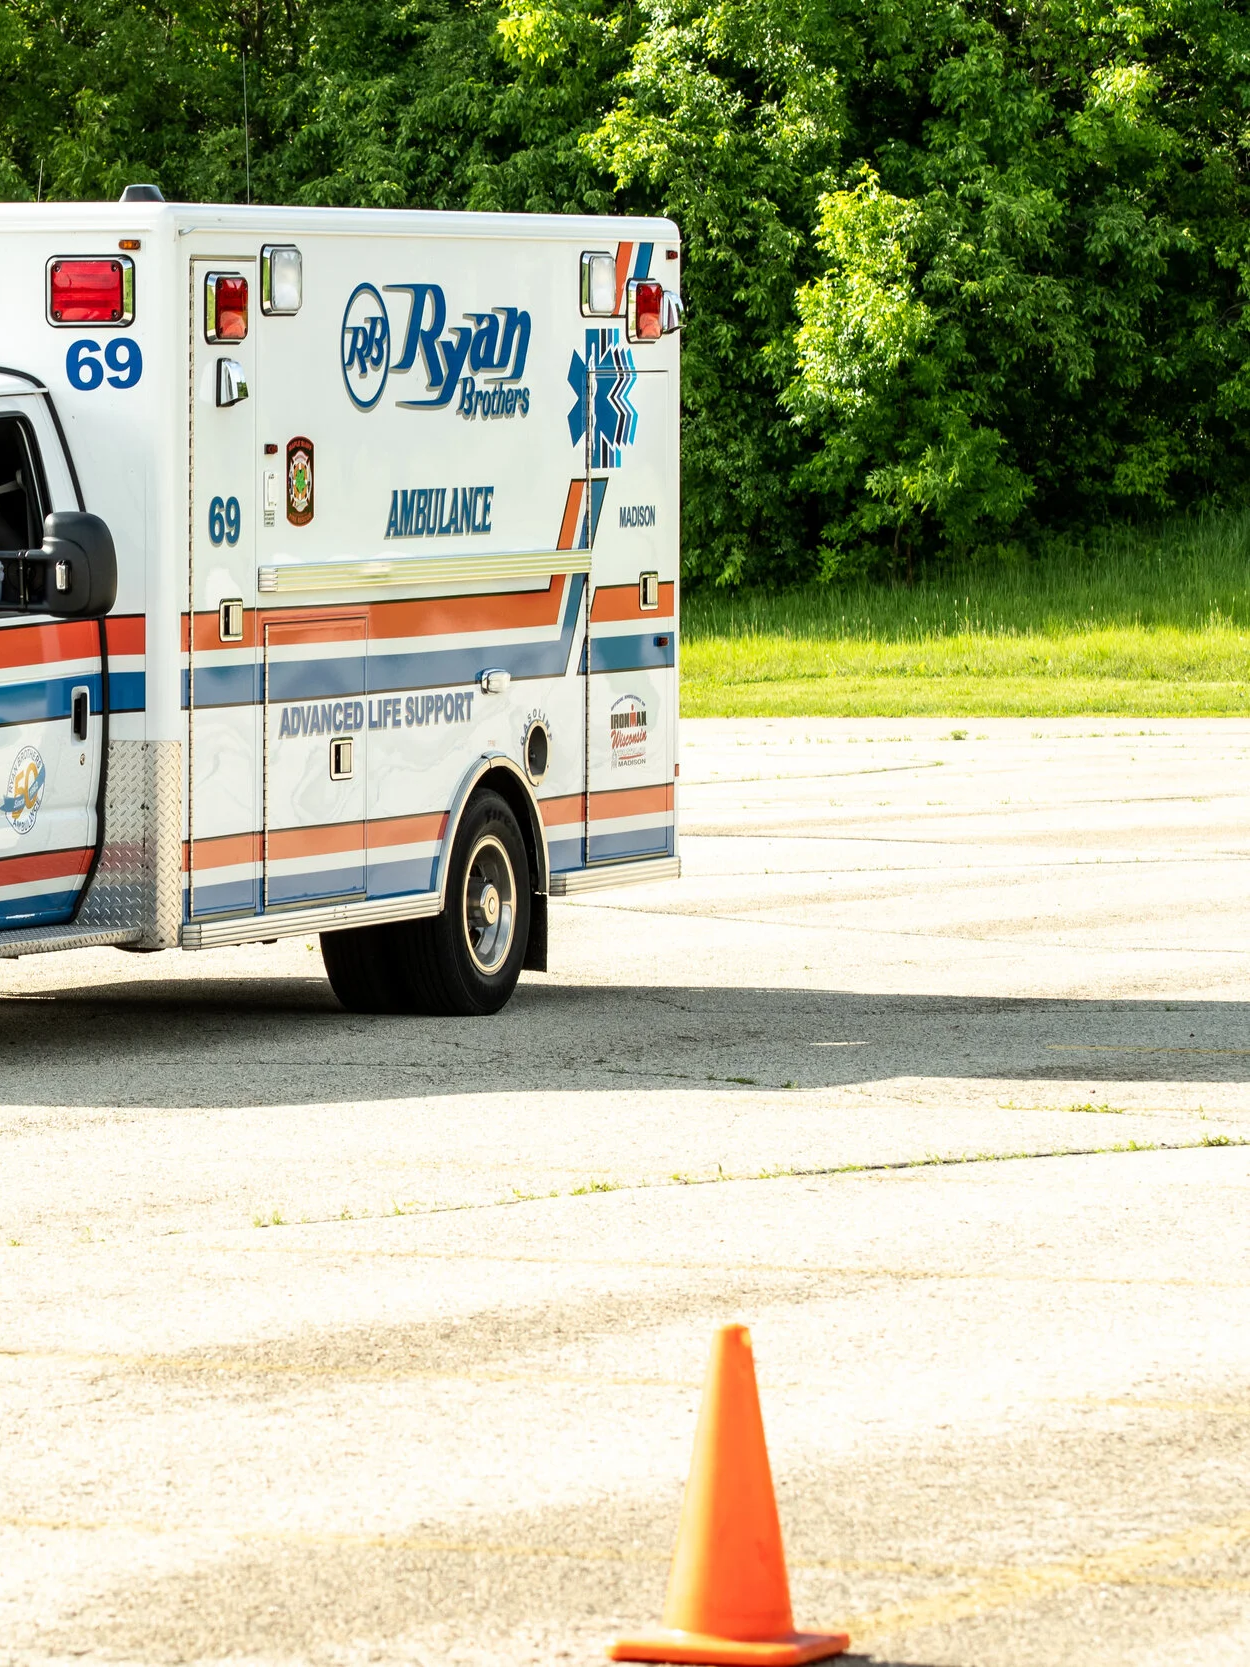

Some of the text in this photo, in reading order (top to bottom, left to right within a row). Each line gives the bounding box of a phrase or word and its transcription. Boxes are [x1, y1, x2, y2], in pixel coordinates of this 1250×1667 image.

[66, 338, 143, 391] 69
[345, 317, 387, 379] RB
[382, 284, 531, 410] Ryan
[456, 377, 530, 421] Brothers
[209, 496, 240, 548] 69
[384, 486, 494, 540] AMBULANCE
[620, 505, 655, 528] MADISON
[278, 691, 474, 739] ADVANCED LIFE SUPPORT
[611, 708, 647, 730] IRONMAN
[611, 728, 647, 749] Wisconsin
[618, 758, 646, 767] MADISON
